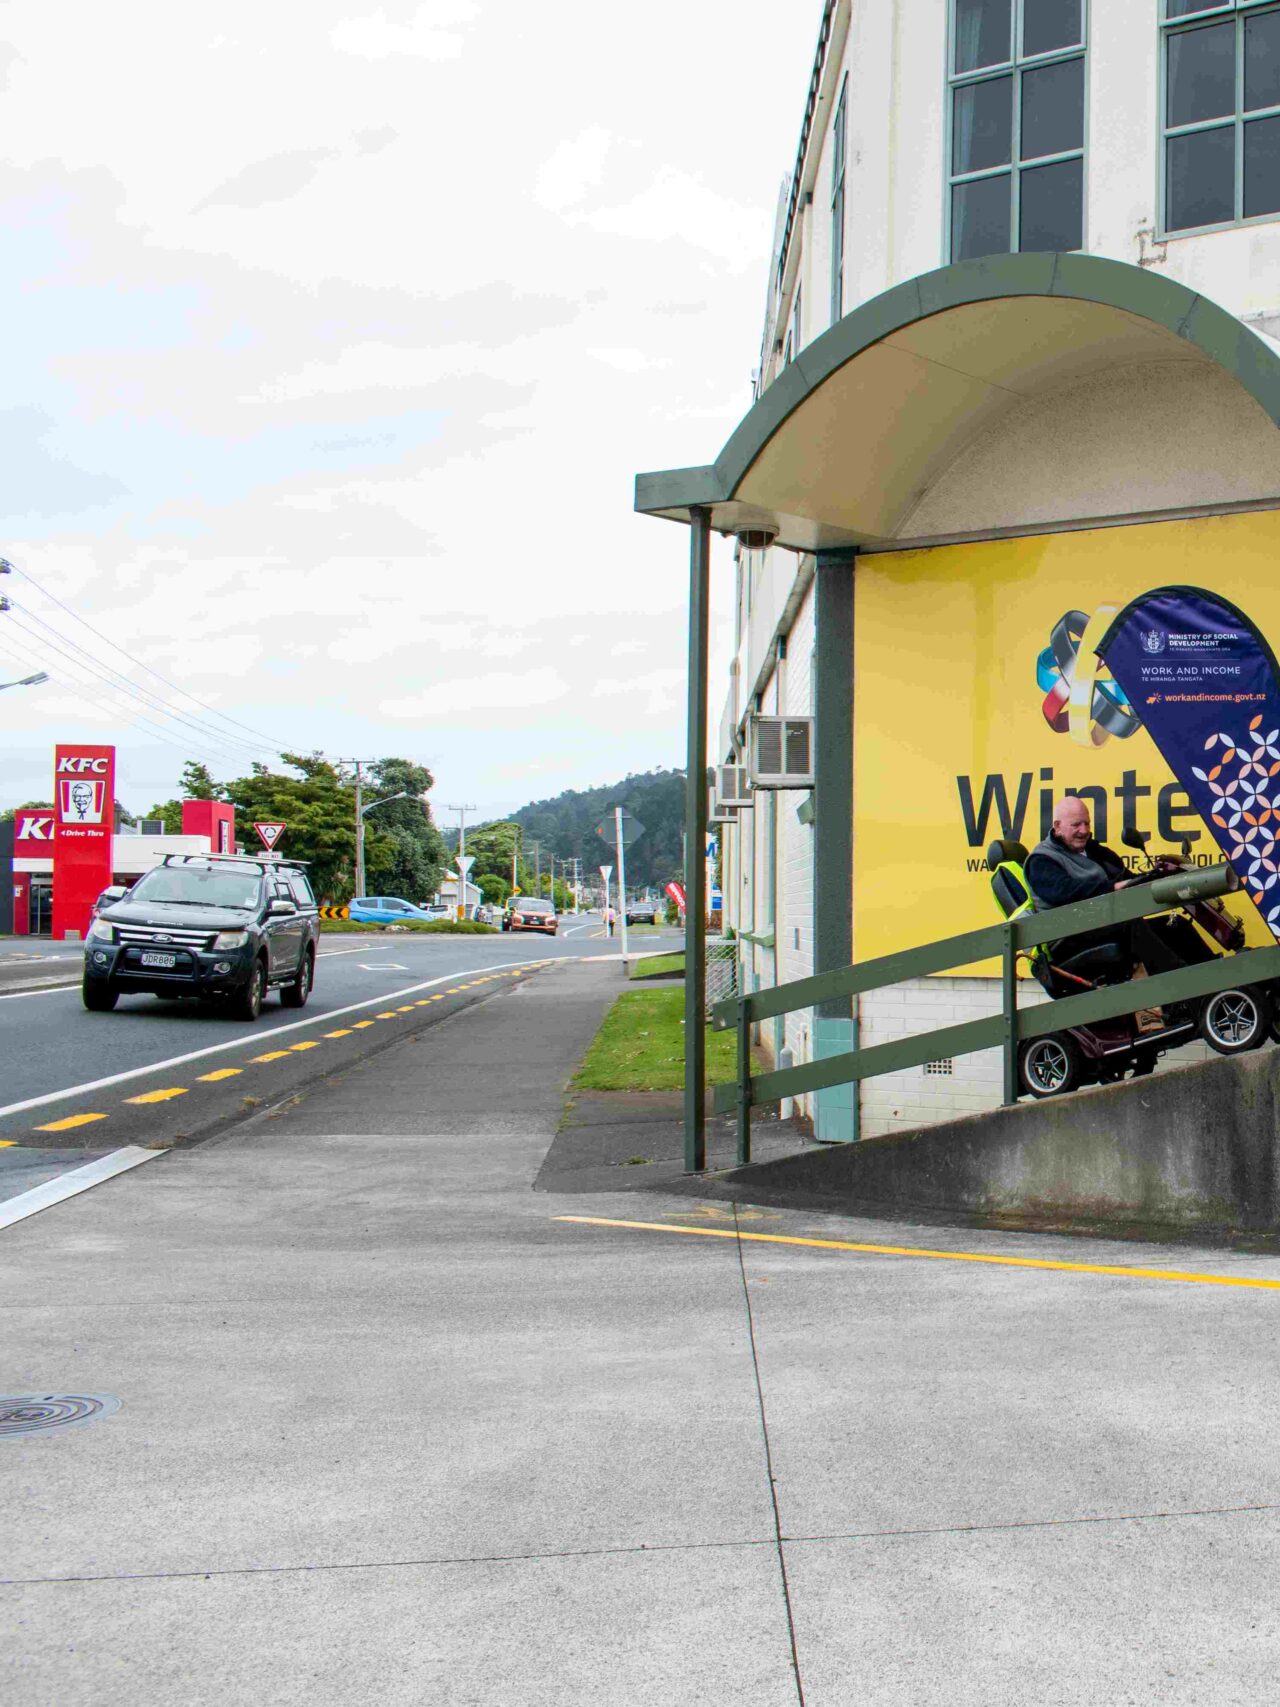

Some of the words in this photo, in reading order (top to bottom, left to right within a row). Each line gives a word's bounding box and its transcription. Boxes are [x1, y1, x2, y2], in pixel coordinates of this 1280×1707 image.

[1141, 666, 1173, 675] WORK
[1176, 666, 1199, 675] AND
[1202, 666, 1241, 675] INCOME
[1164, 692, 1267, 703] workandincome.govt.nz
[56, 757, 109, 774] KFC
[65, 829, 86, 837] Drive
